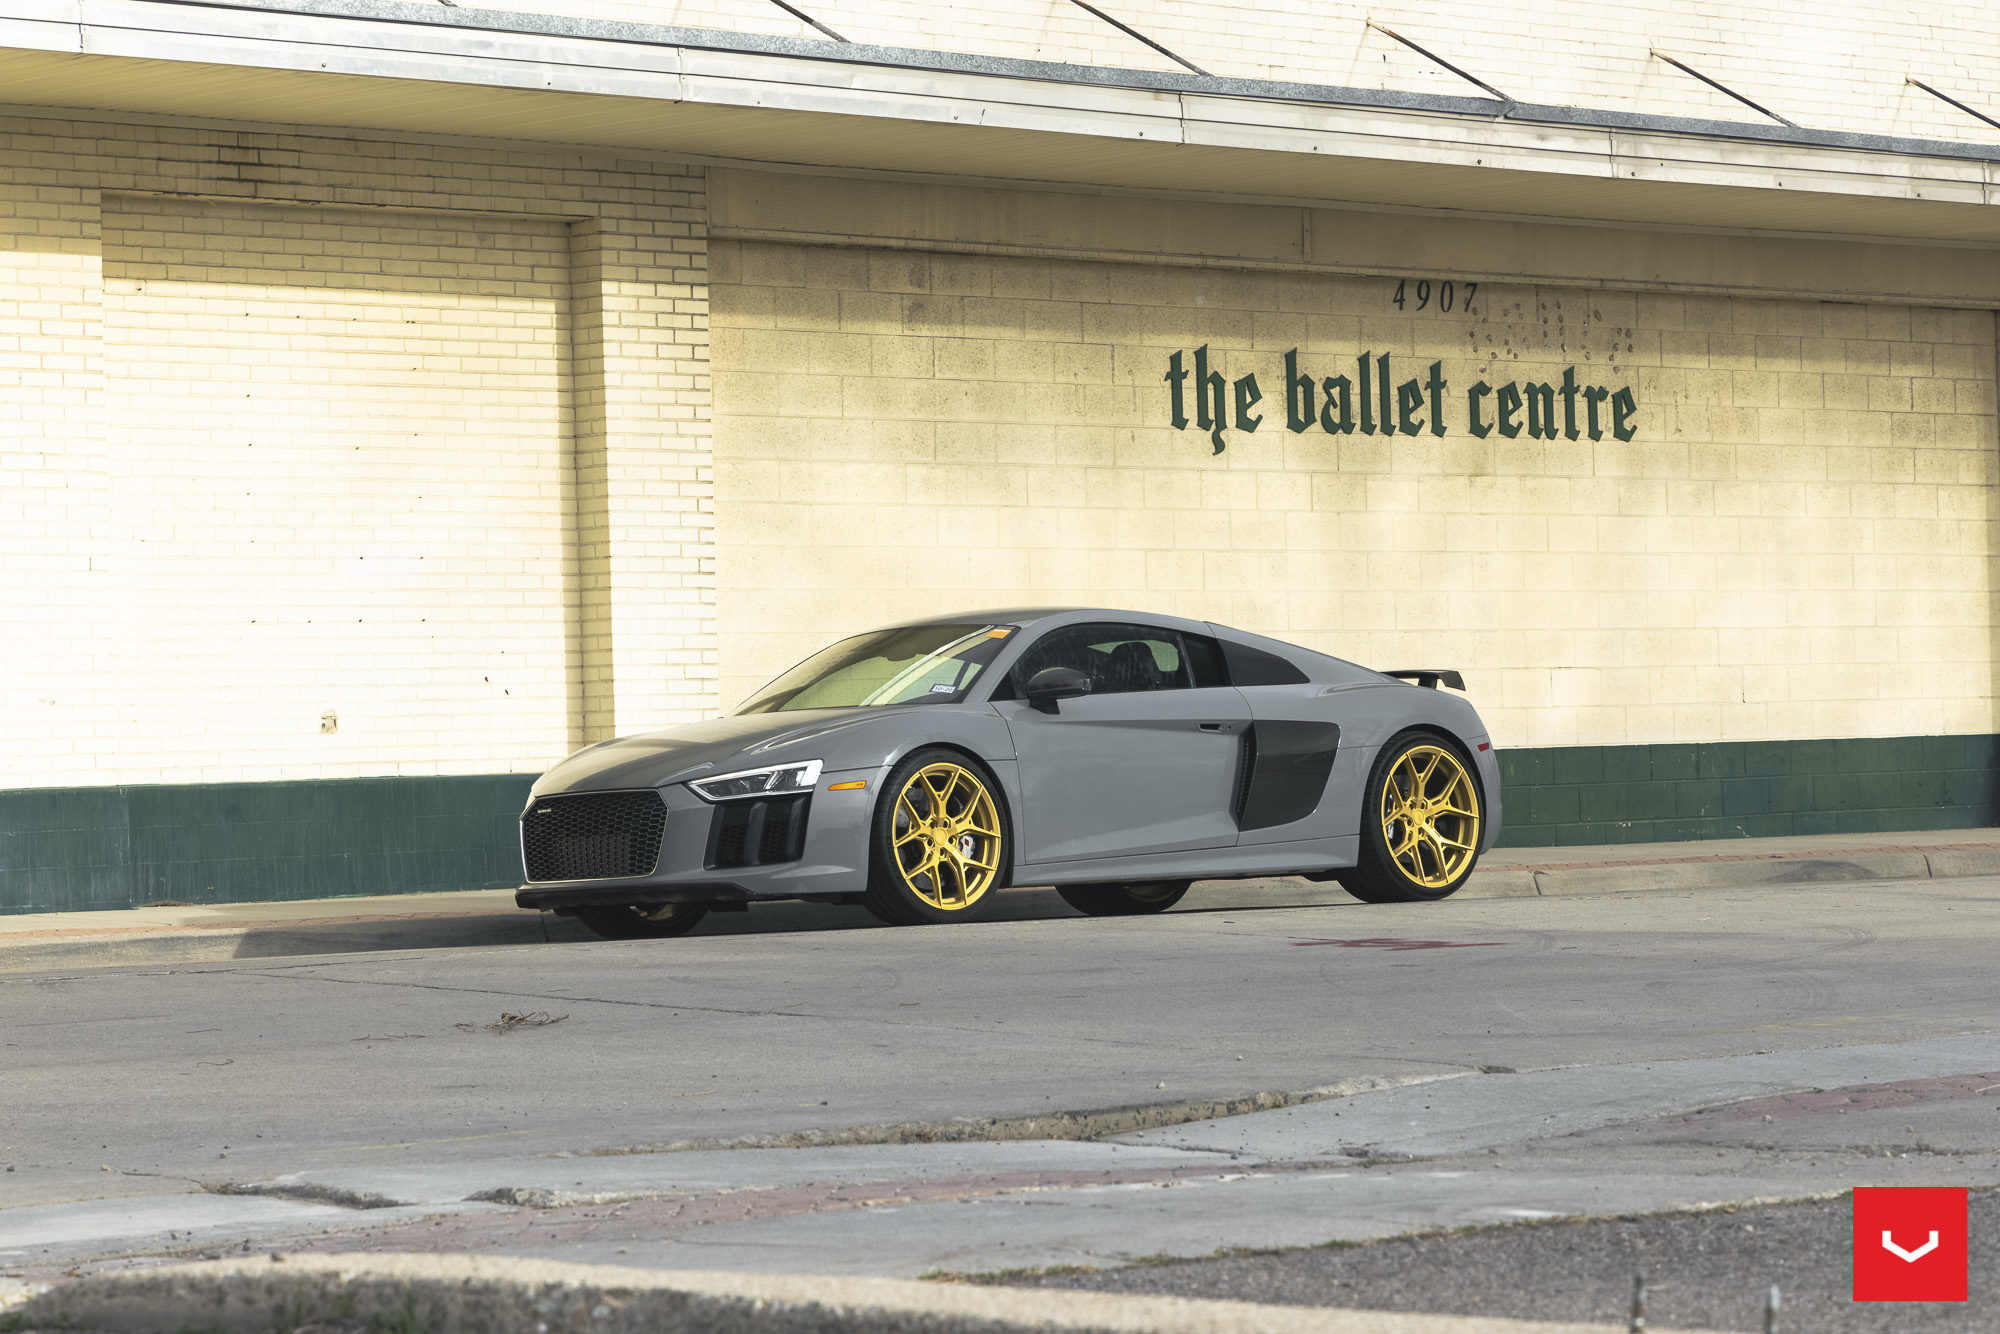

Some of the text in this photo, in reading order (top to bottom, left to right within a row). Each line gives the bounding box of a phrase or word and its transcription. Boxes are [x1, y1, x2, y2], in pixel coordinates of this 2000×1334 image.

[1393, 279, 1479, 313] 4907
[1164, 344, 1638, 456] the ballet centre
